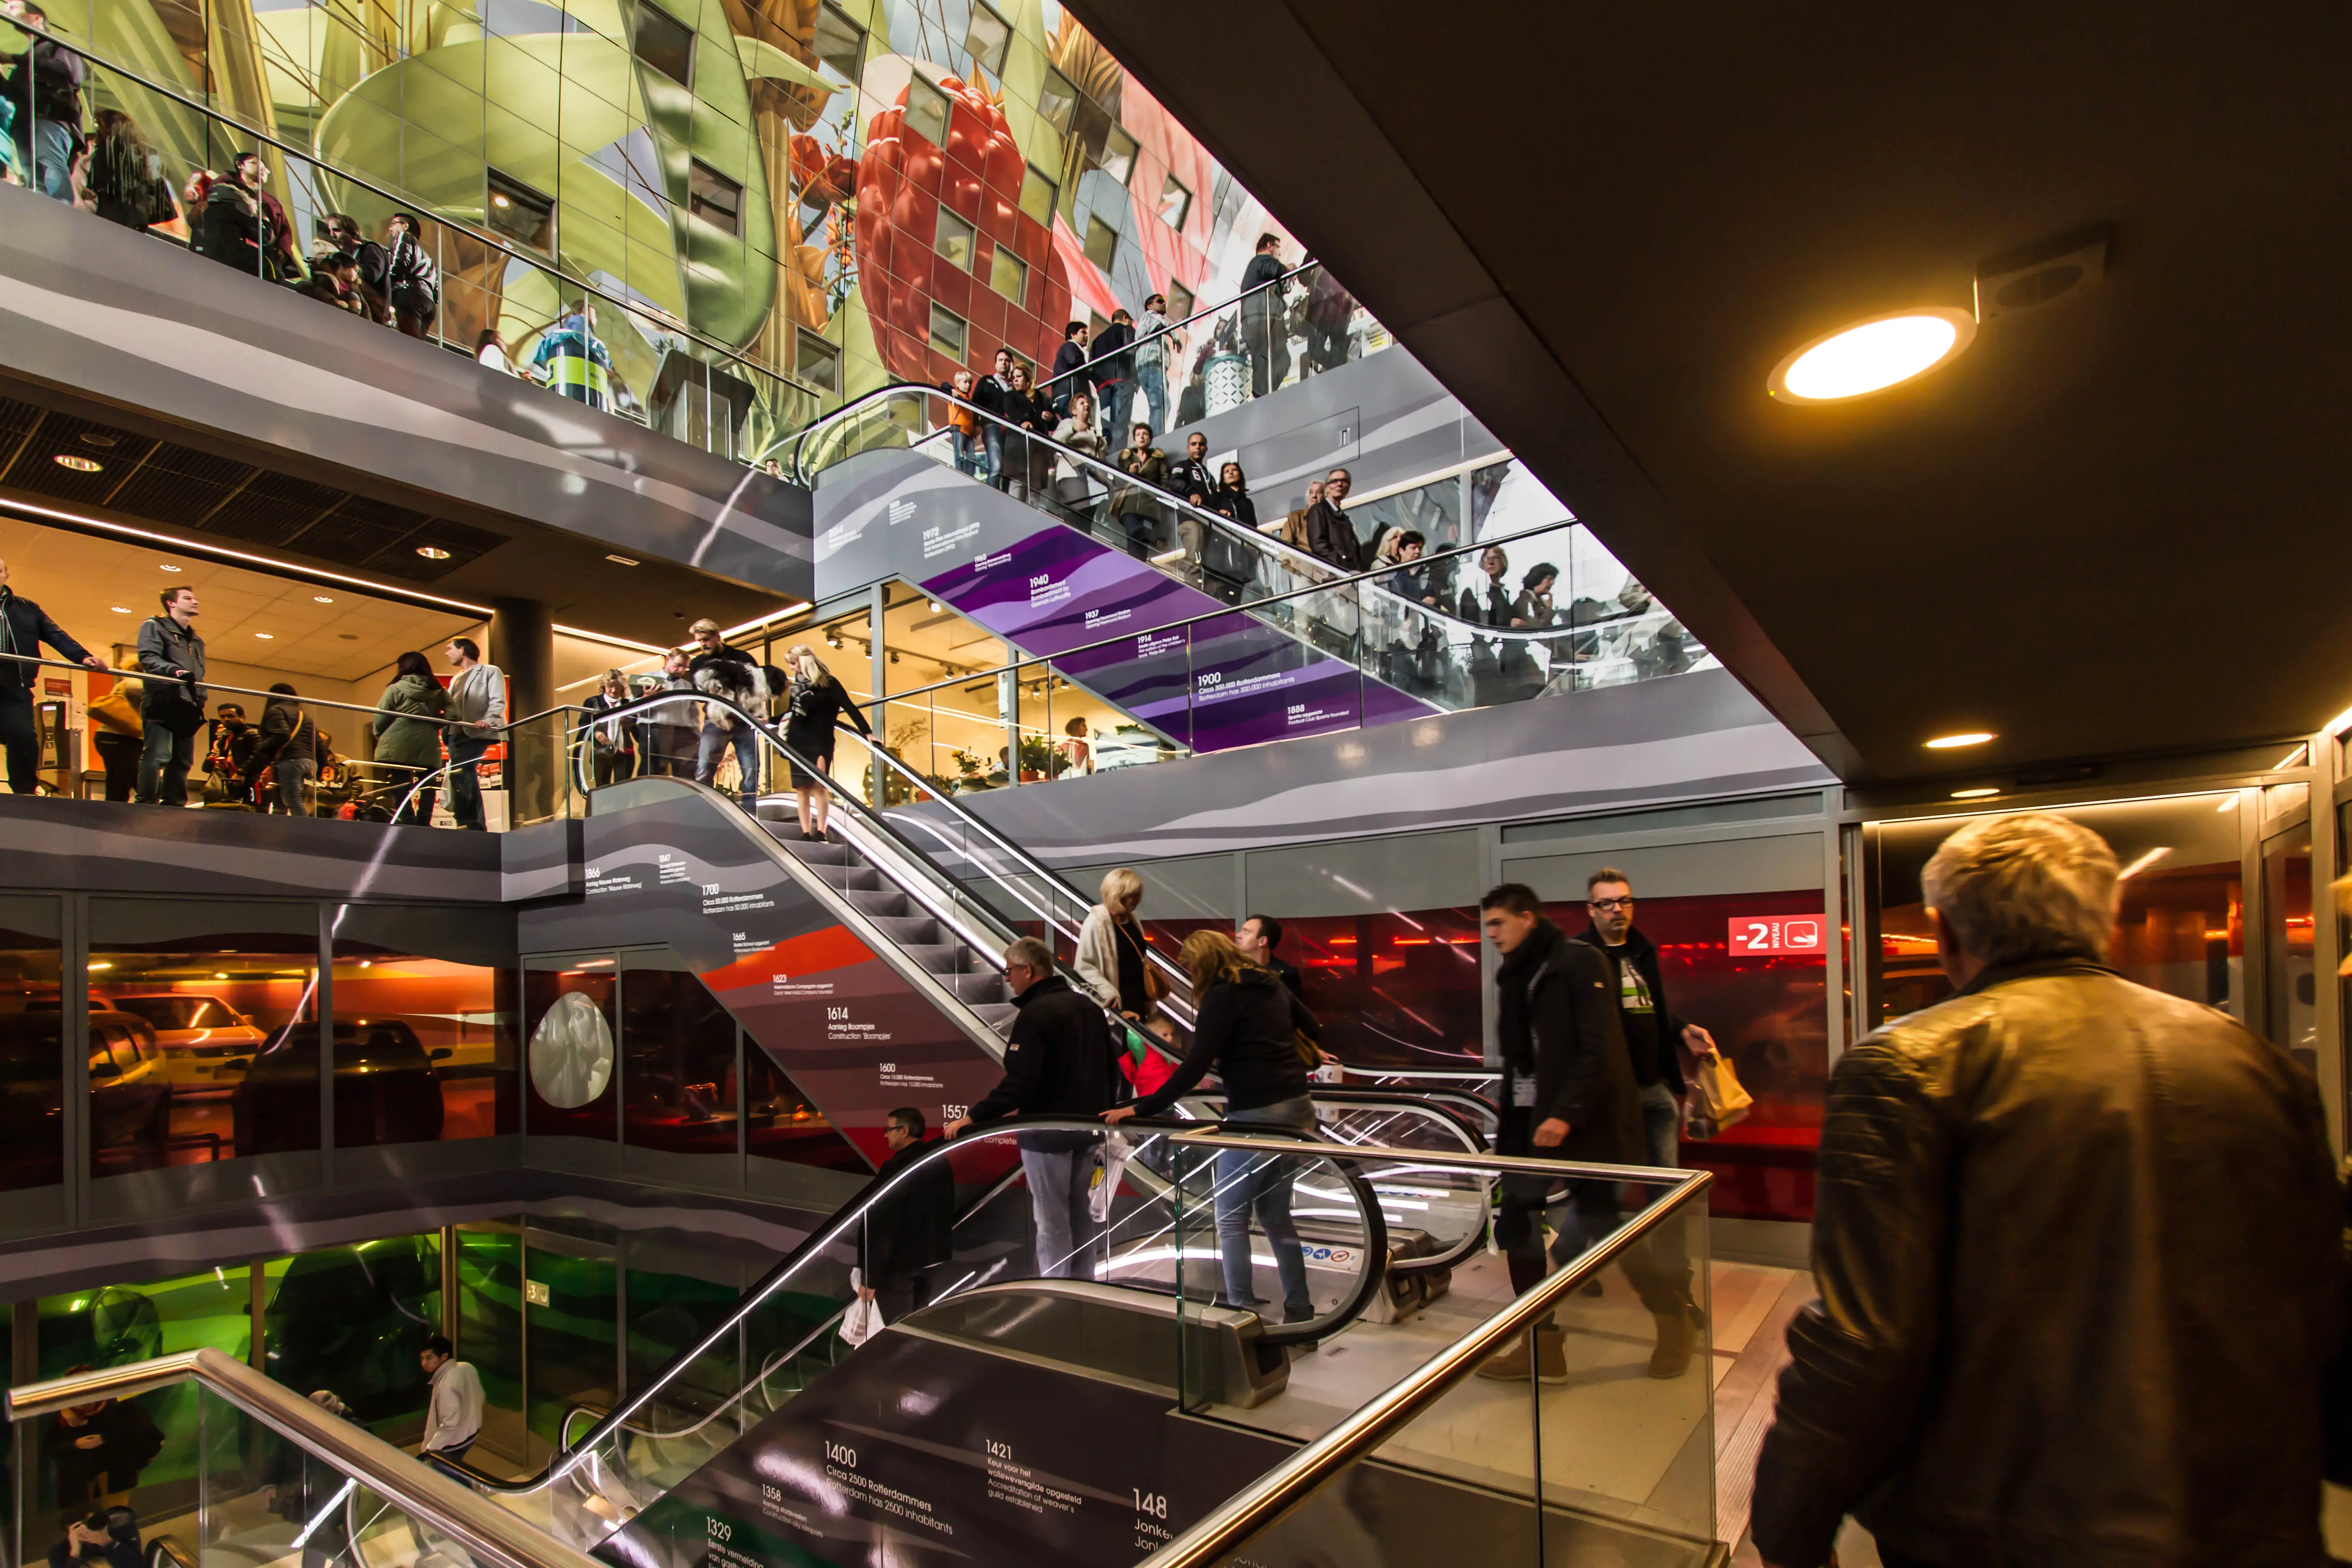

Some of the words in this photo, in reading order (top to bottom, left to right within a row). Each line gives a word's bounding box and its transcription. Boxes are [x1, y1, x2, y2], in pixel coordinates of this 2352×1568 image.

[923, 527, 939, 540] 1972
[1030, 574, 1049, 588] 1940
[1085, 609, 1099, 619] 1937
[1138, 634, 1152, 644] 1914
[1198, 672, 1221, 686] 1900
[1198, 686, 1214, 695] Circa
[1236, 672, 1281, 686] Rotterdammers
[1199, 690, 1228, 701] Rotterdam
[1262, 676, 1295, 688] inhabitants
[1288, 704, 1305, 715] 1888
[585, 867, 600, 879] 1866
[702, 883, 720, 896] 1700
[732, 932, 746, 941] 1665
[1736, 923, 1769, 949] -2
[1772, 922, 1780, 948] NIVEAU
[773, 974, 787, 983] 1623
[827, 1007, 848, 1020] 1614
[828, 1024, 847, 1032] Aanleg
[848, 1023, 875, 1031] Boompjes
[879, 1063, 896, 1073] 1600
[942, 1104, 968, 1119] 1557
[825, 1441, 856, 1468] 1400
[986, 1439, 1011, 1460] 1421
[988, 1457, 1002, 1468] Keur
[1004, 1463, 1019, 1475] voor
[1020, 1467, 1031, 1478] het
[762, 1484, 781, 1502] 1358
[827, 1465, 847, 1480] Circa
[849, 1472, 867, 1488] 2500
[868, 1480, 932, 1512] Rotterdammers
[988, 1469, 1044, 1493] wolleweversgilde
[1045, 1488, 1082, 1505] opgesteld
[988, 1478, 1033, 1499] Accreditation
[1043, 1497, 1074, 1514] weaver's
[988, 1489, 1004, 1500] guild
[1005, 1494, 1043, 1514] established
[827, 1478, 867, 1502] Rotterdam
[868, 1494, 883, 1508] has
[885, 1499, 904, 1516] 2500
[905, 1507, 953, 1535] inhabitants
[706, 1516, 731, 1542] 1329
[708, 1538, 726, 1553] Eerste
[708, 1552, 720, 1564] van
